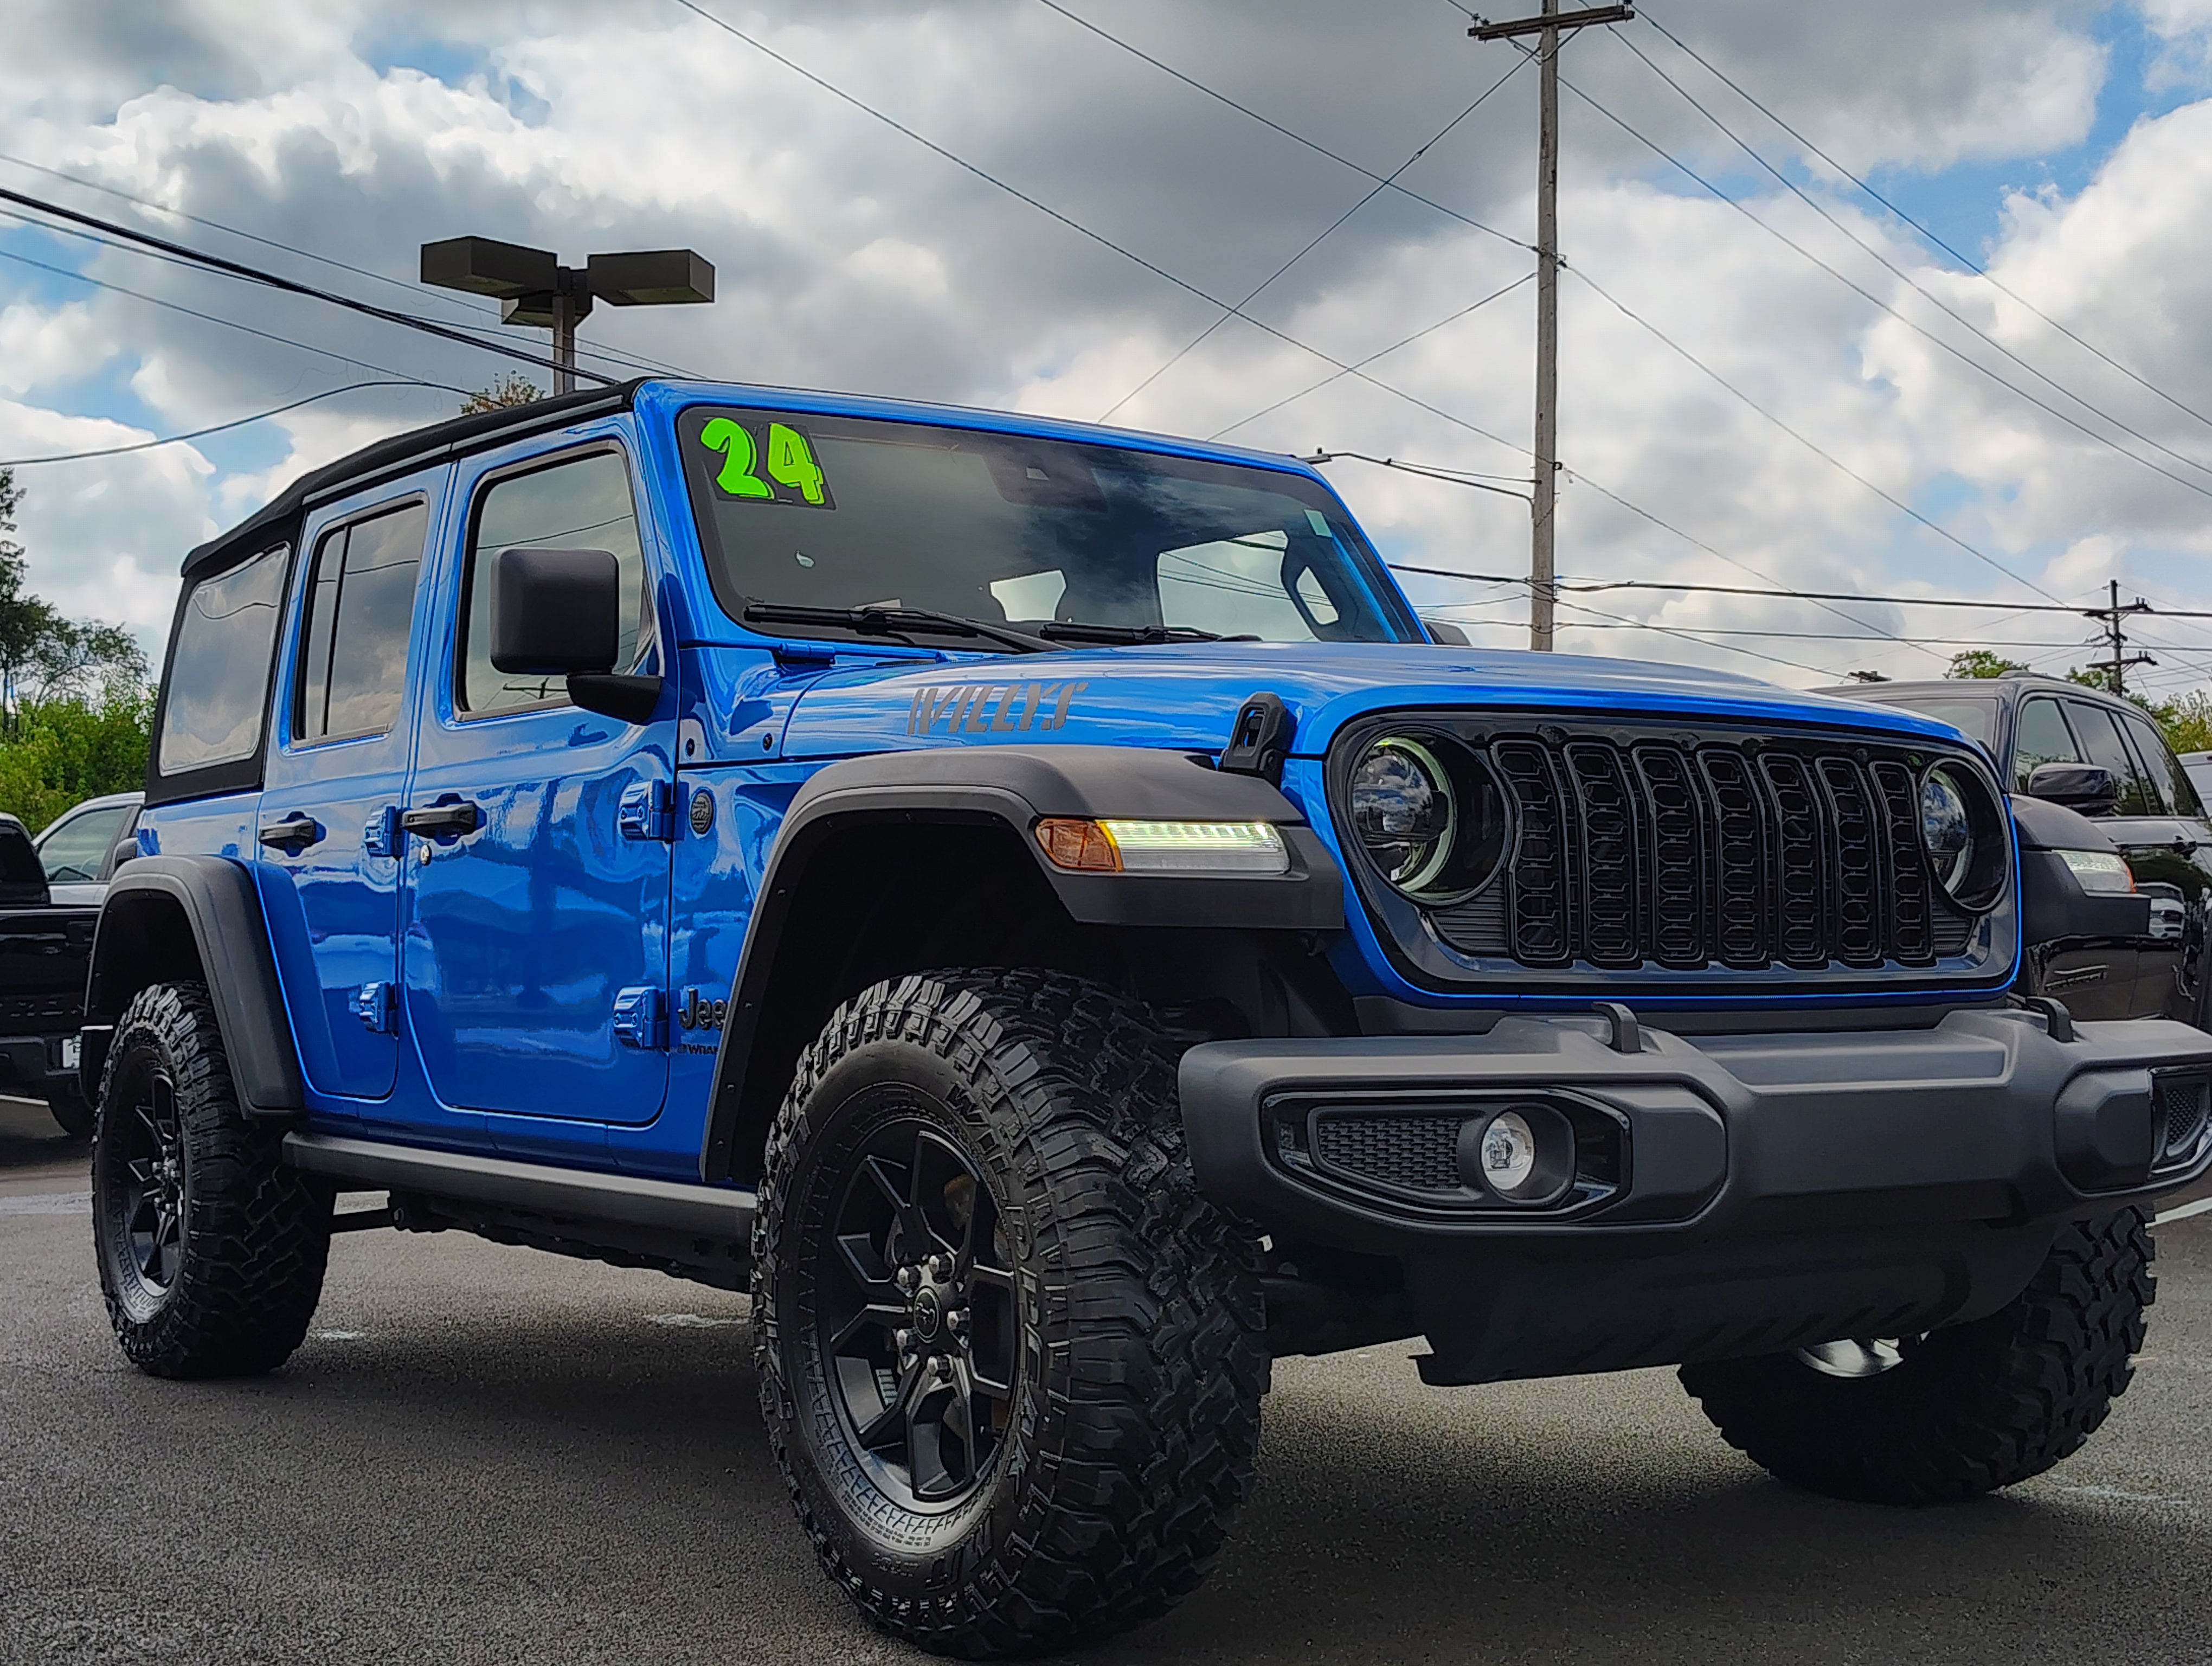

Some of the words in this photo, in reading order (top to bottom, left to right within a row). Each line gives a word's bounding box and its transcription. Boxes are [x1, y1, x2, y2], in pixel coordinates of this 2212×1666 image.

[700, 417, 825, 505] 24
[907, 682, 1089, 736] WILLYS
[677, 988, 728, 1029] Jee
